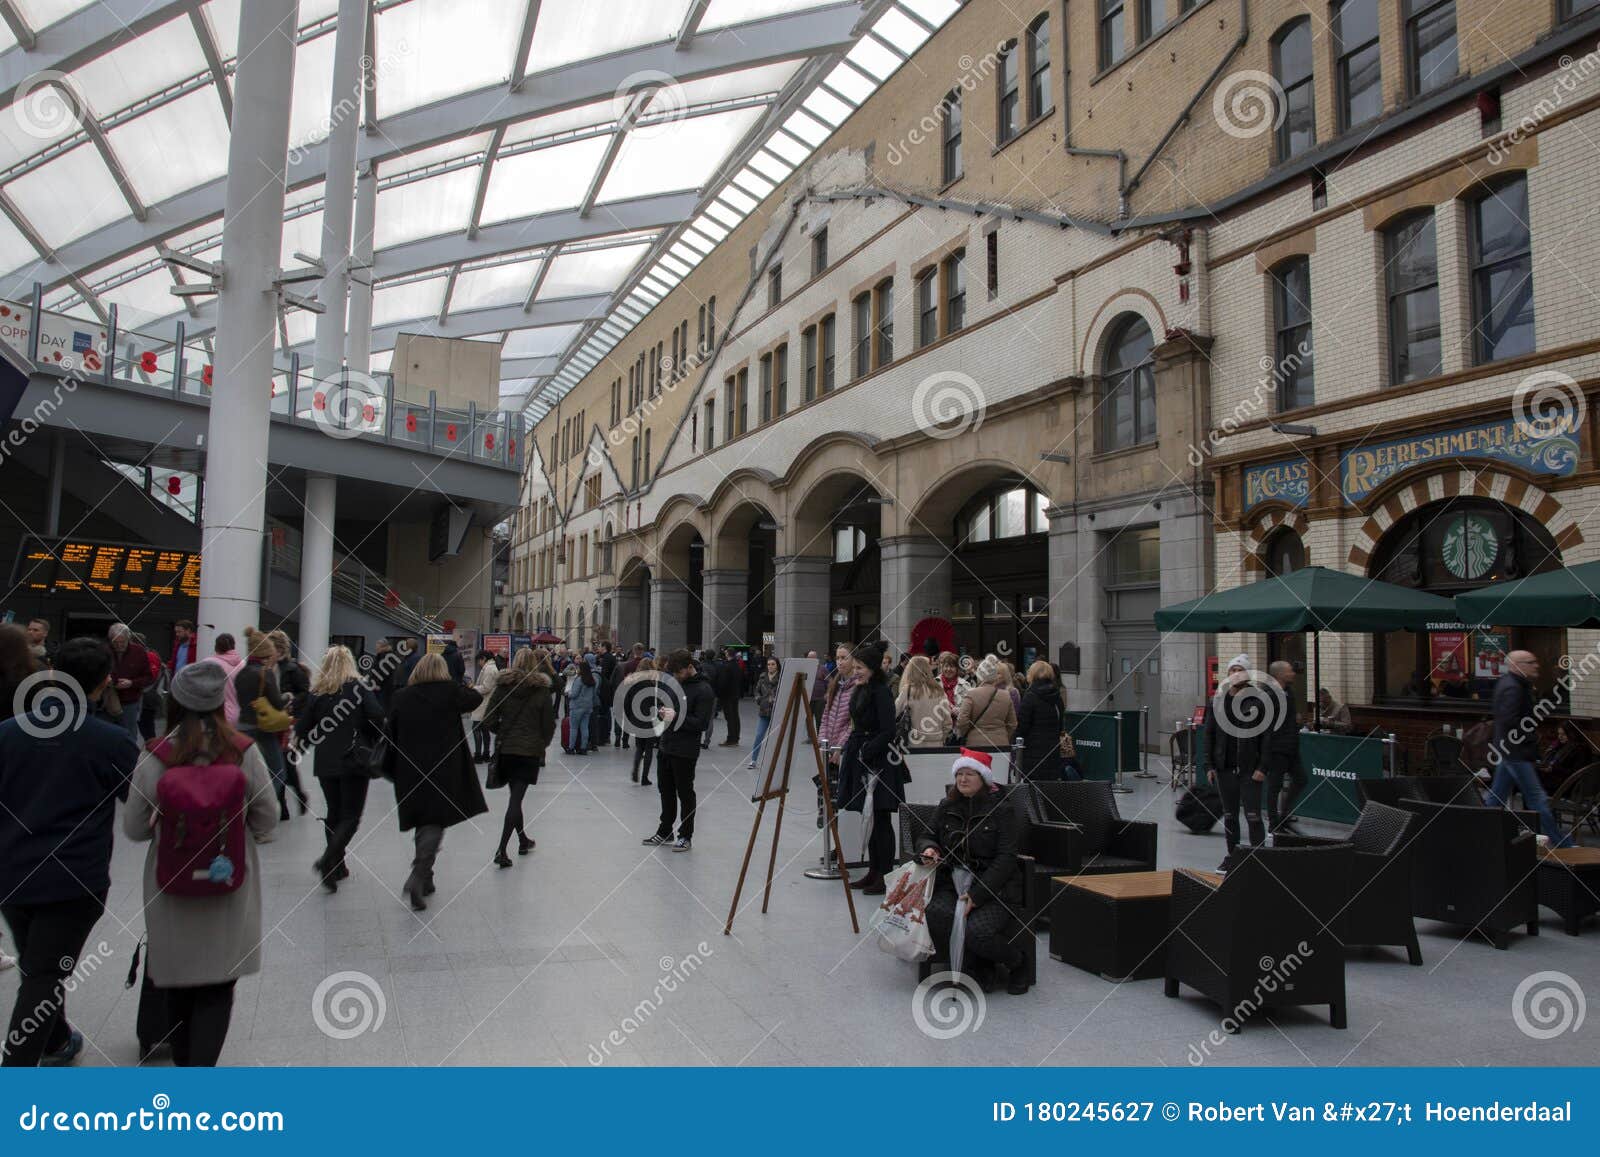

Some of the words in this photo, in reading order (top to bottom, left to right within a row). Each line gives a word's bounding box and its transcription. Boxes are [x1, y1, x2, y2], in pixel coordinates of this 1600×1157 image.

[41, 333, 66, 348] DAY
[1348, 425, 1505, 494] REFRESHMENT
[1513, 413, 1574, 443] ROOM
[1262, 462, 1309, 497] CLASS
[1312, 767, 1357, 781] STARBUCKS
